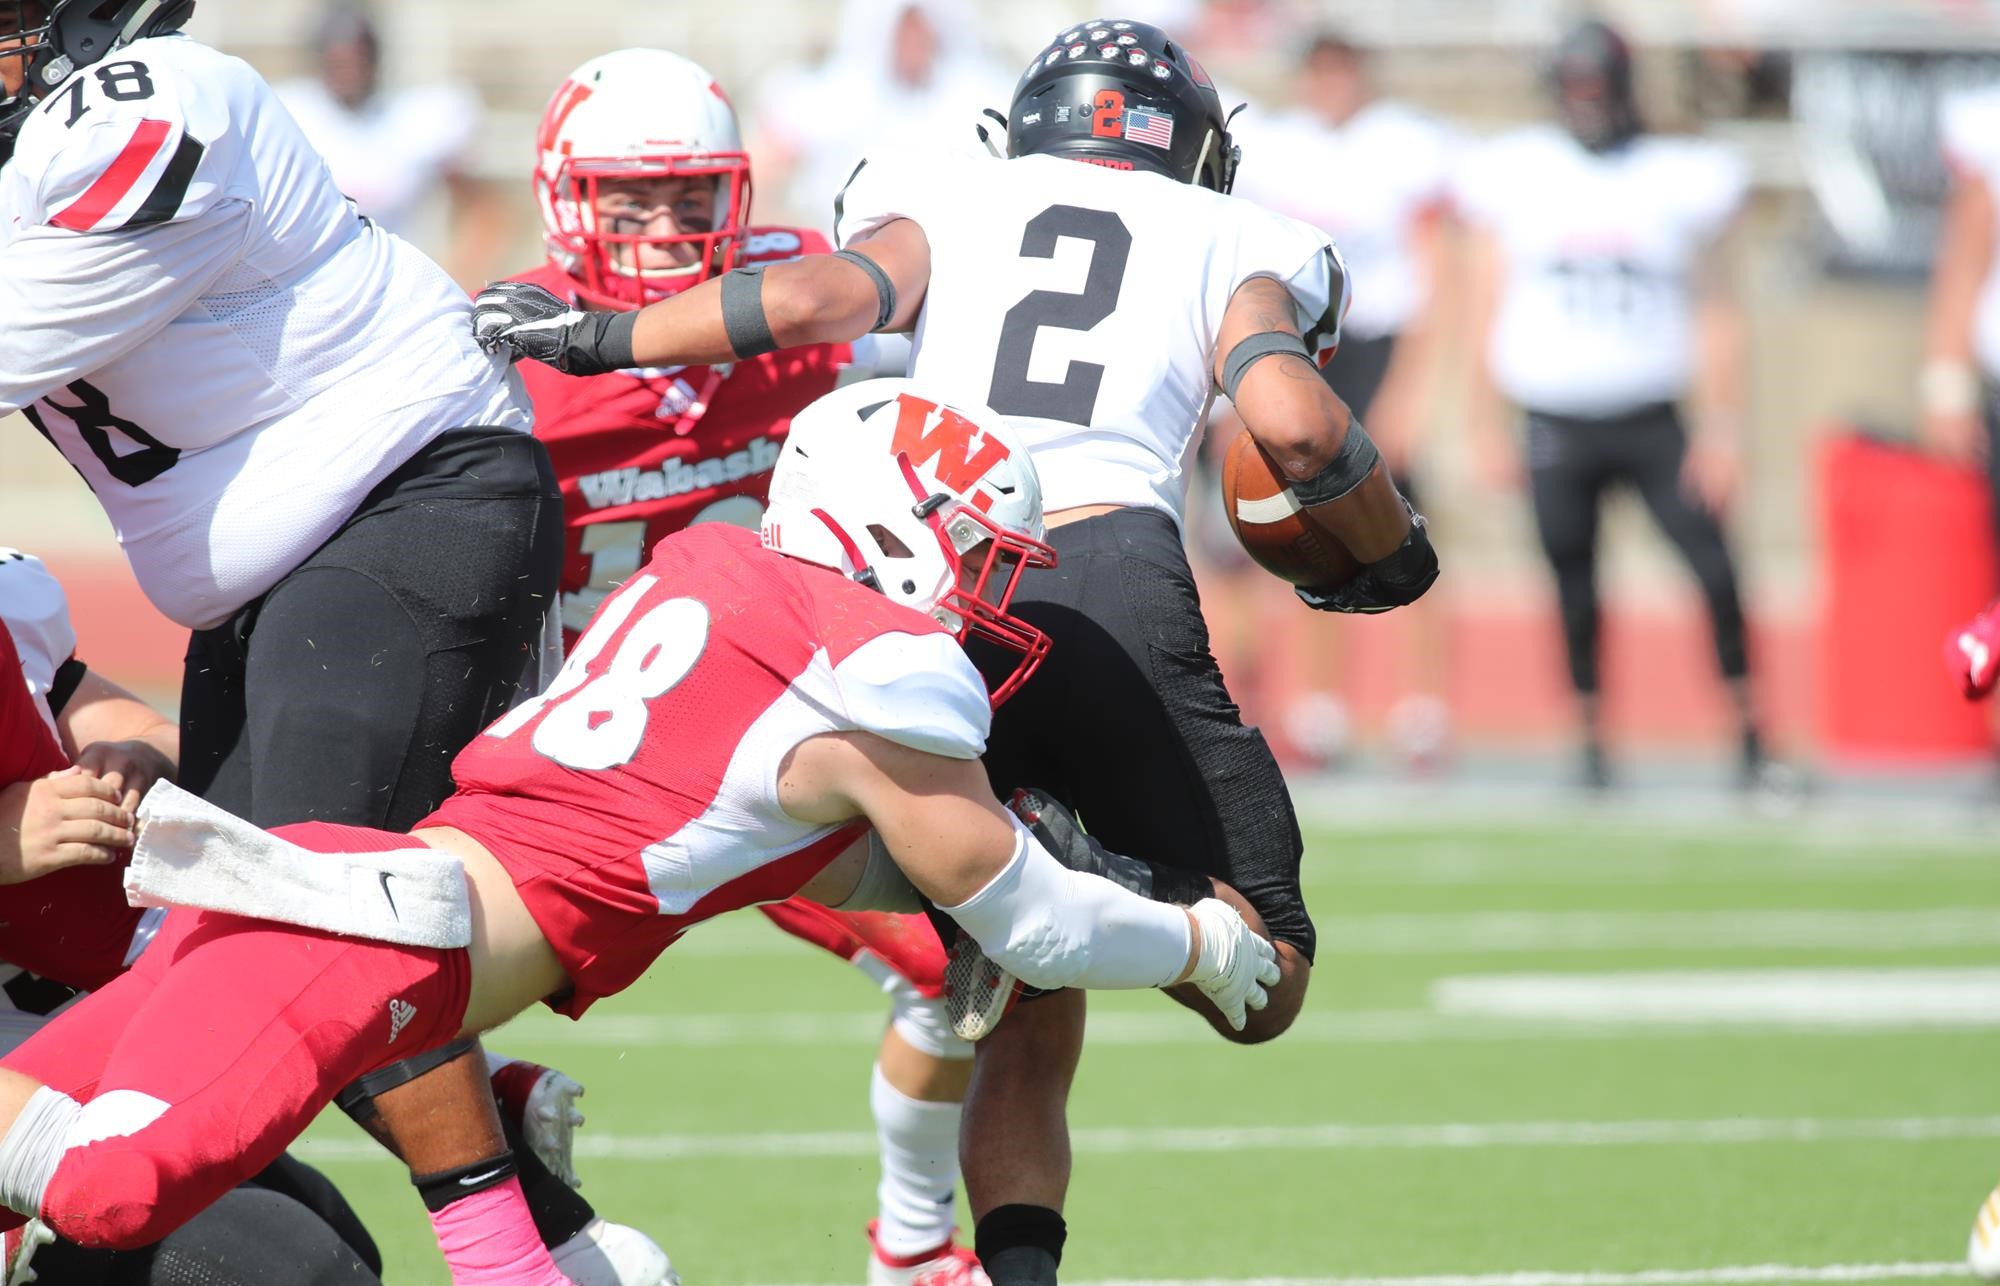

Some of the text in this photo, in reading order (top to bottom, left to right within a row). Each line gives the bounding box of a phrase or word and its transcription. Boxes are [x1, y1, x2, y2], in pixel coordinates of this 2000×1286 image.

[44, 60, 155, 129] 78
[1092, 89, 1125, 138] 2
[987, 204, 1134, 427] 2
[579, 436, 780, 509] Wabash
